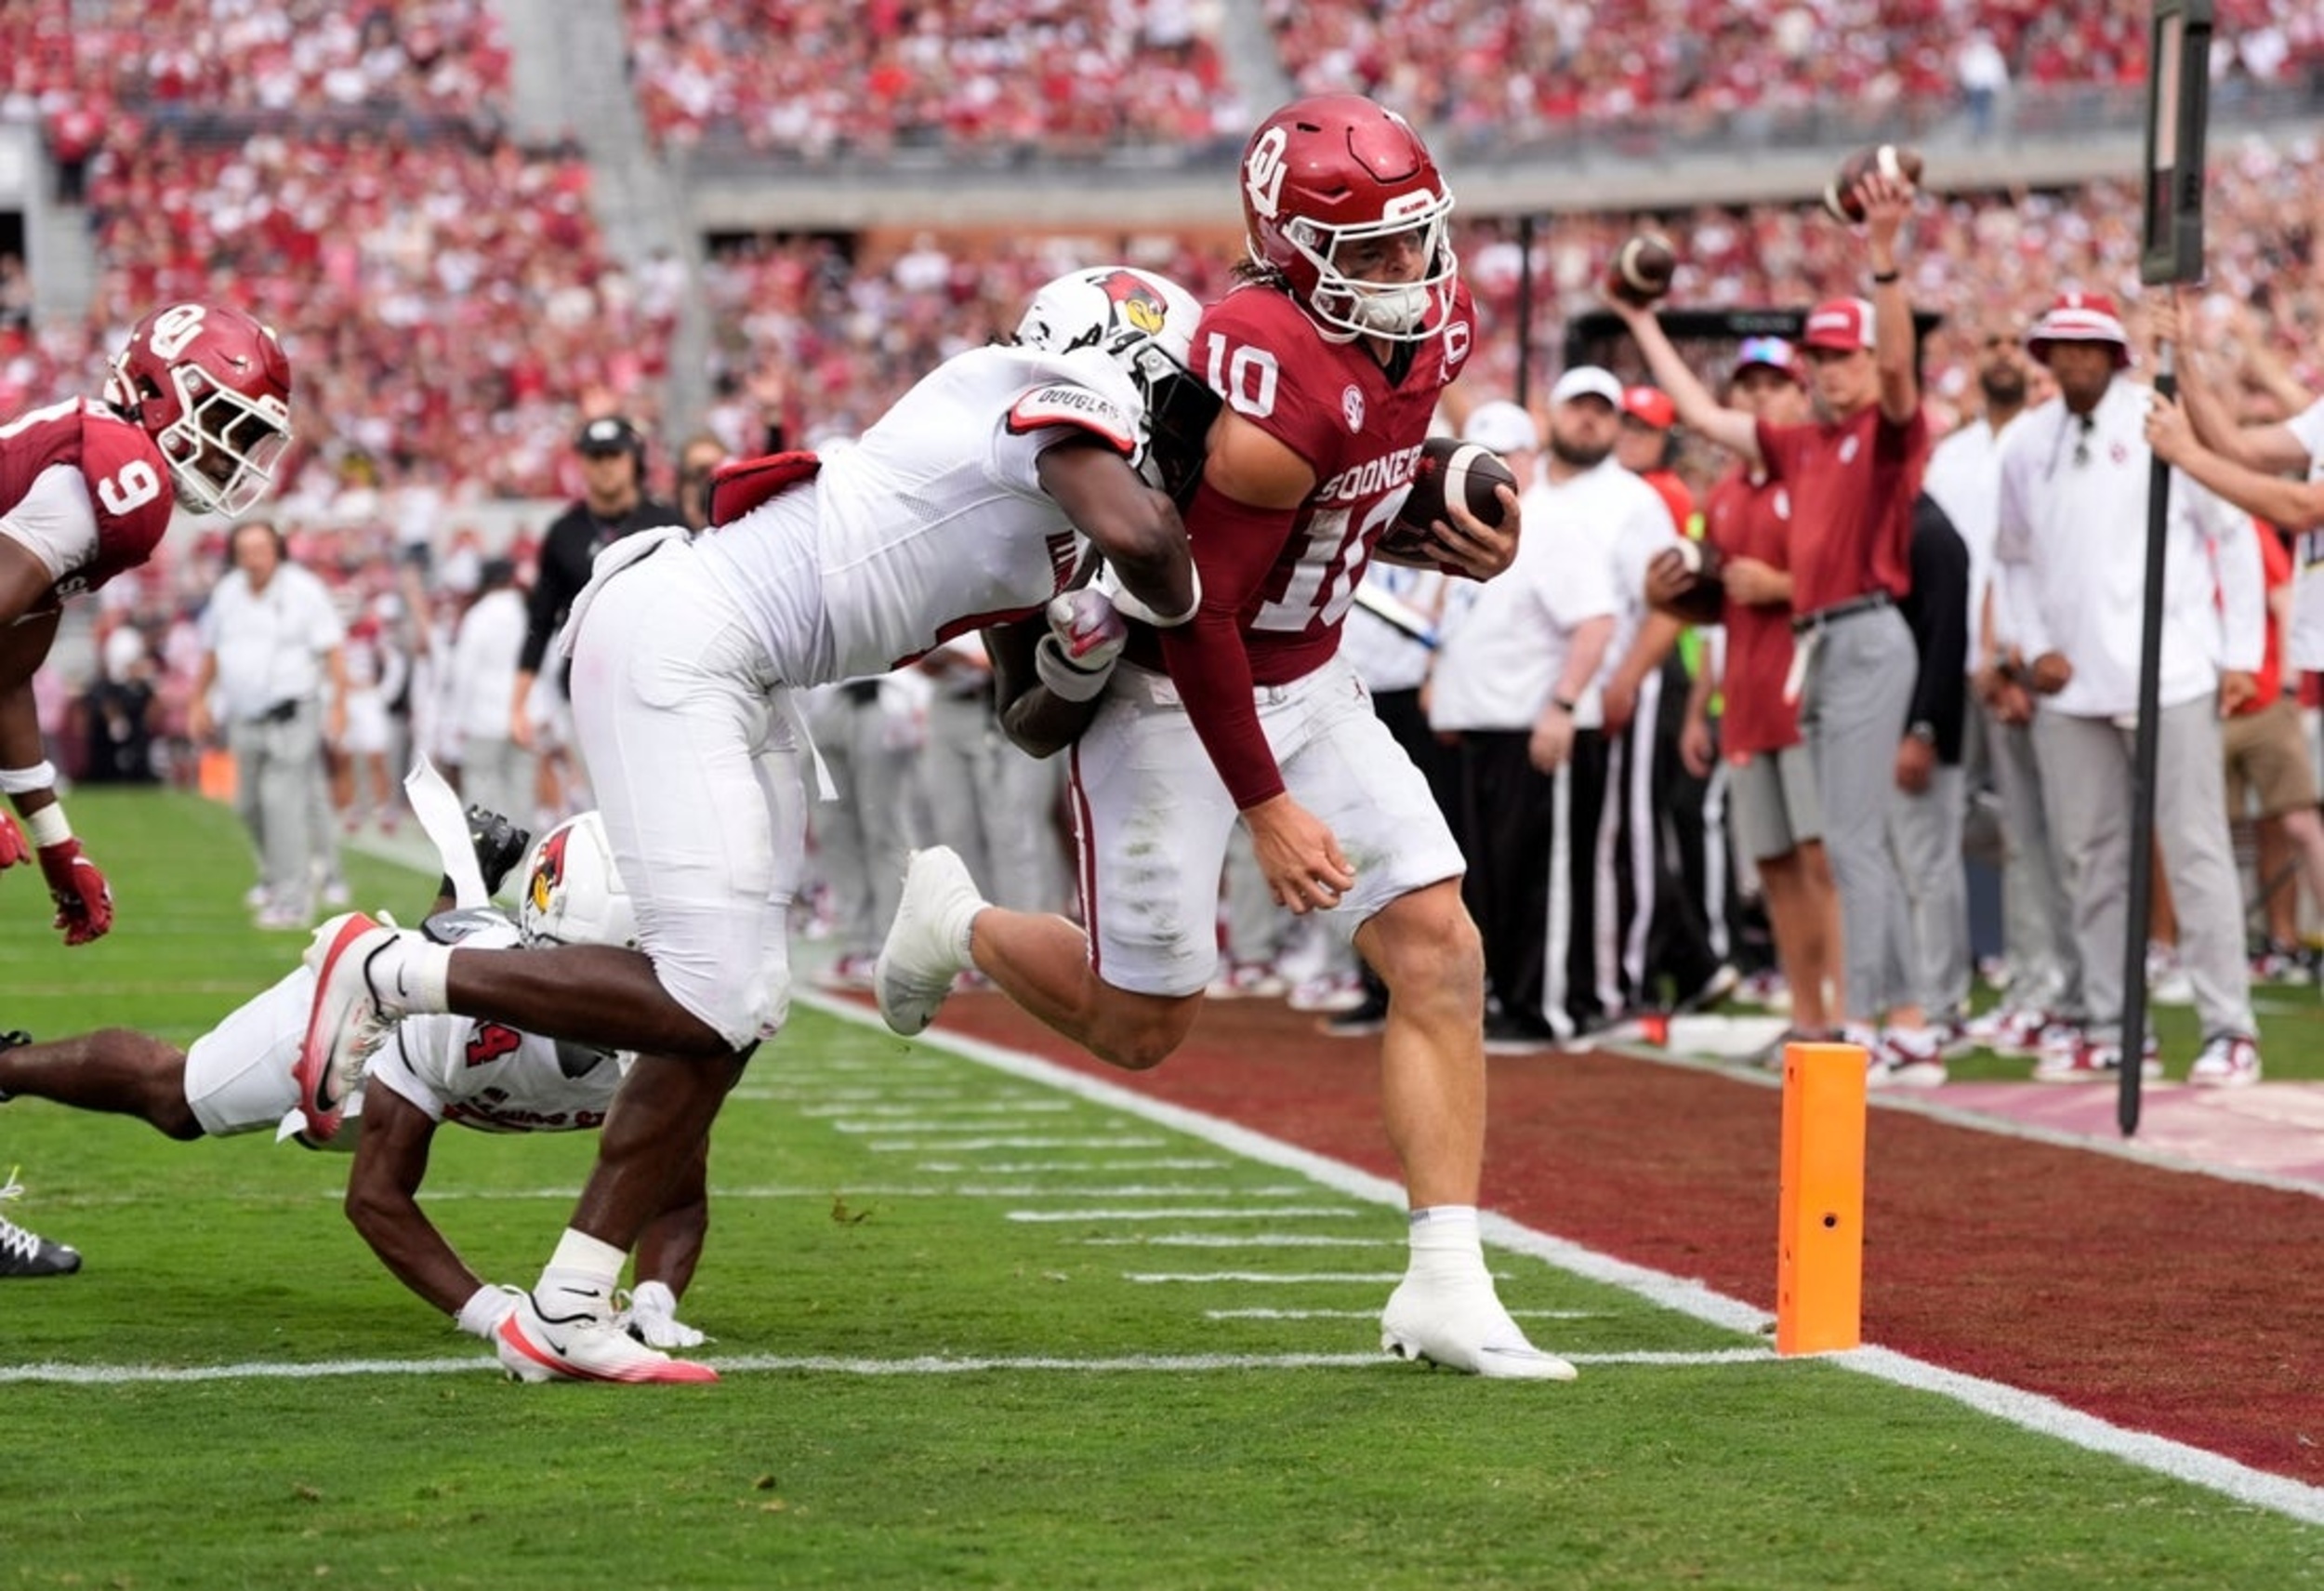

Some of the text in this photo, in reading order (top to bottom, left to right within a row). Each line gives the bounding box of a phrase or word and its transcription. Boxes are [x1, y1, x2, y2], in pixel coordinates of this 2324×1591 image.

[1208, 331, 1279, 418] 10
[99, 460, 160, 516] 9
[1314, 444, 1423, 502] SOONER
